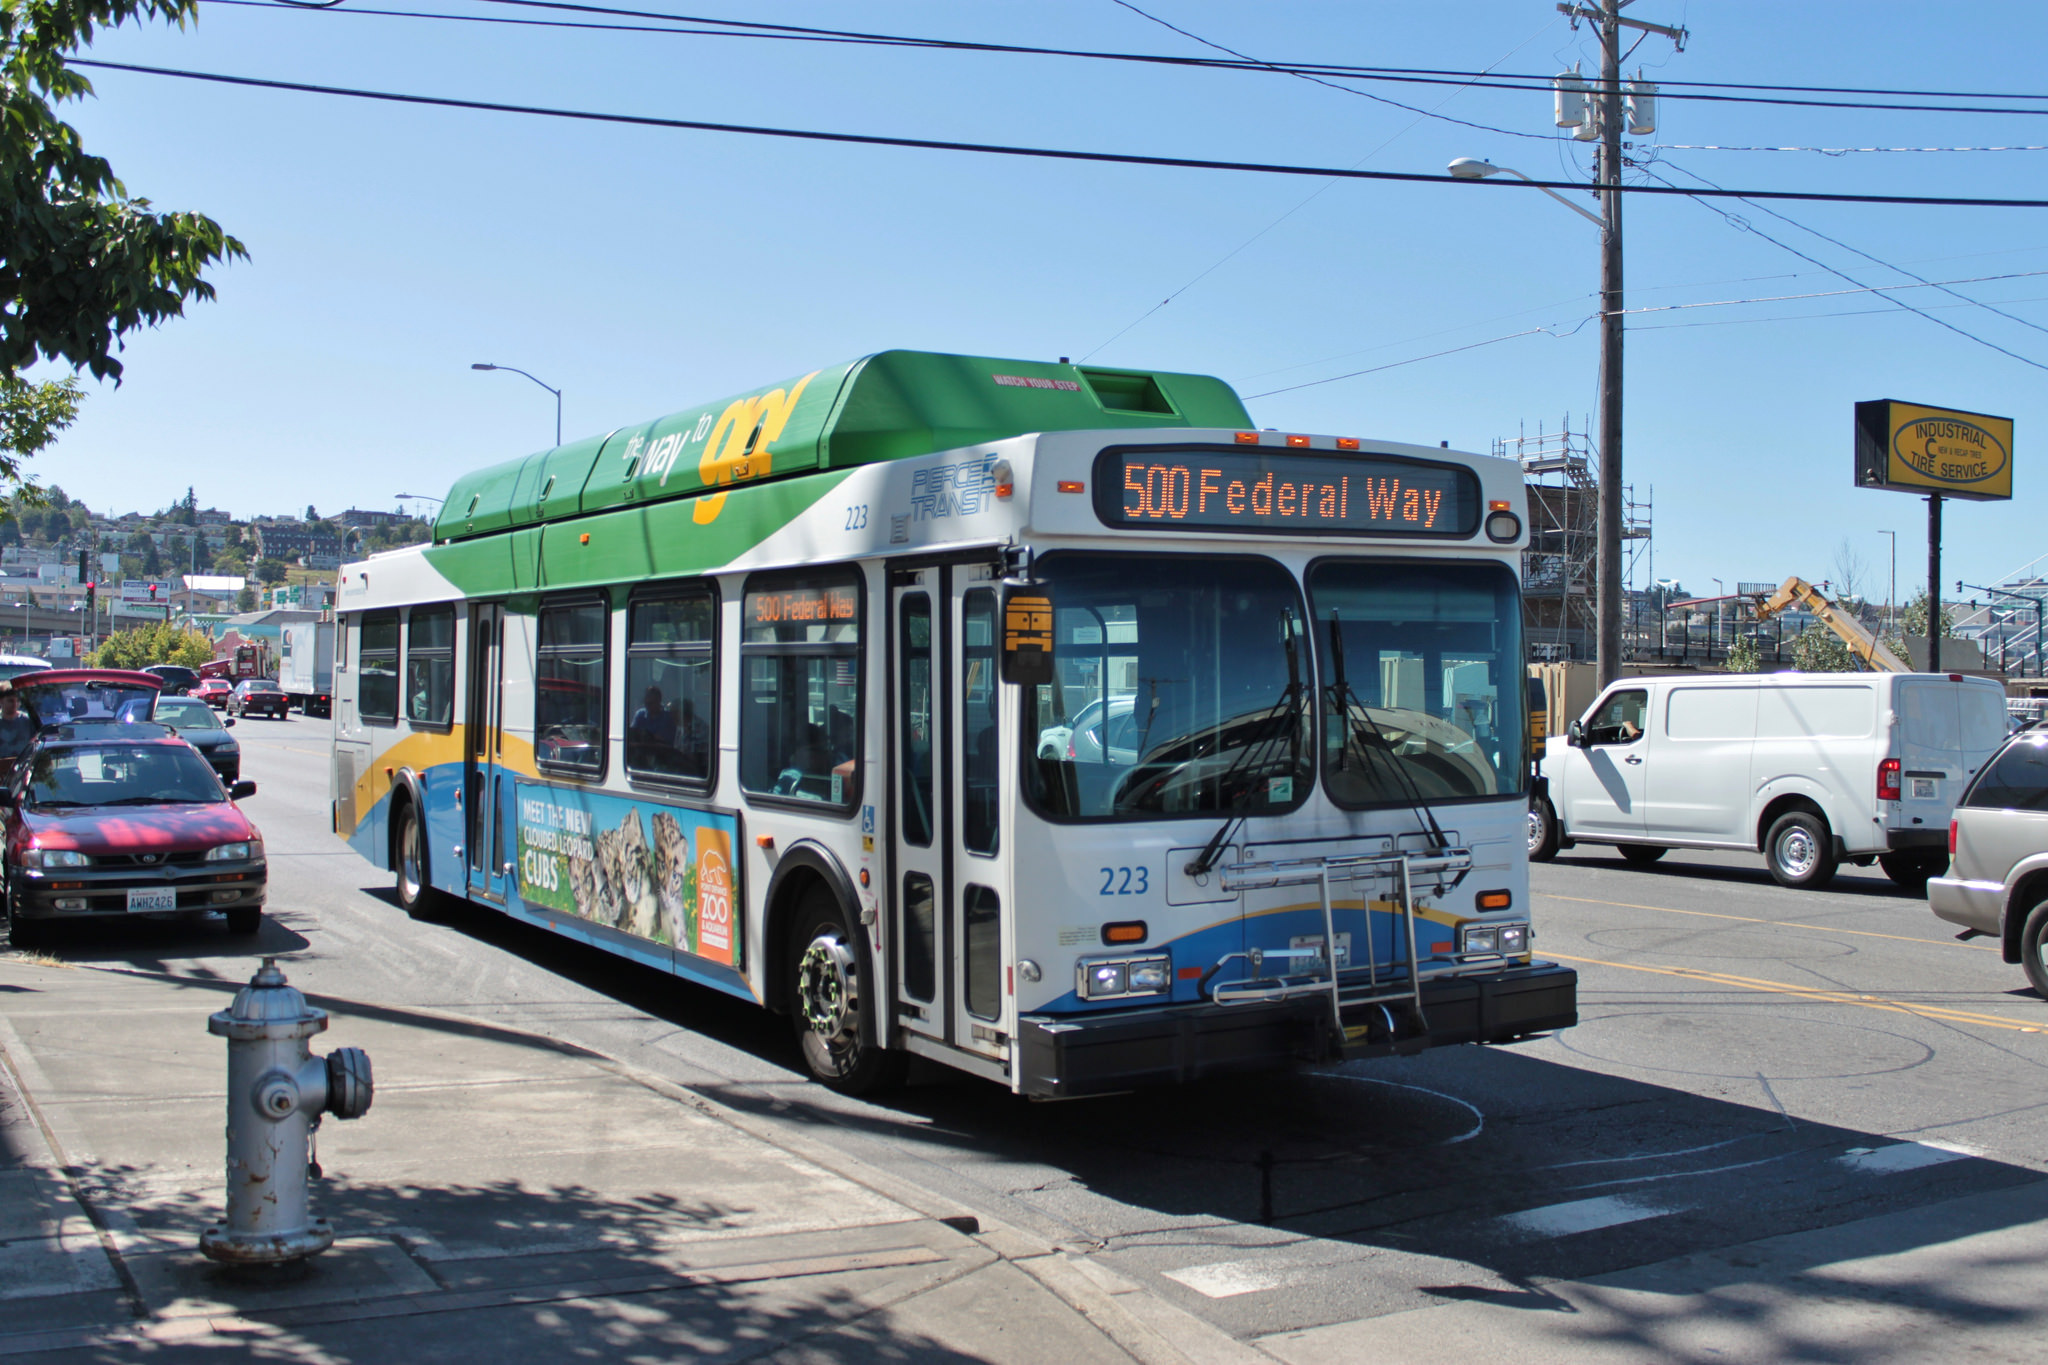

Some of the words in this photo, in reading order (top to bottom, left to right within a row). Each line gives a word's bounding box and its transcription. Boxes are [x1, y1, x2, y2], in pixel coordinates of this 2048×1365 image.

[993, 375, 1027, 387] WATCH
[1027, 377, 1055, 389] YOUR
[1054, 381, 1078, 392] STEP
[691, 412, 713, 443] to
[1915, 422, 1987, 450] INDUSTRIAL
[623, 431, 645, 460] the
[634, 430, 691, 487] way
[692, 369, 822, 525] go
[911, 459, 986, 497] PIERCE
[1911, 450, 1935, 474] TIRE
[1940, 461, 1989, 478] SERVICE
[911, 485, 996, 522] TRANSIT
[1123, 463, 1190, 519] 500
[1199, 469, 1348, 519] Federal
[1367, 477, 1441, 528] Way
[845, 504, 868, 531] 223
[756, 596, 781, 622] 500
[783, 592, 828, 621] Federal
[830, 591, 854, 619] Way
[523, 799, 545, 825] MEET
[547, 804, 563, 829] THE
[565, 807, 593, 836] NEW
[523, 826, 557, 852] CLOUDED
[559, 834, 594, 862] LEOPARD
[524, 849, 558, 892] CUBS
[1100, 866, 1149, 895] 223
[702, 892, 728, 924] ZOO
